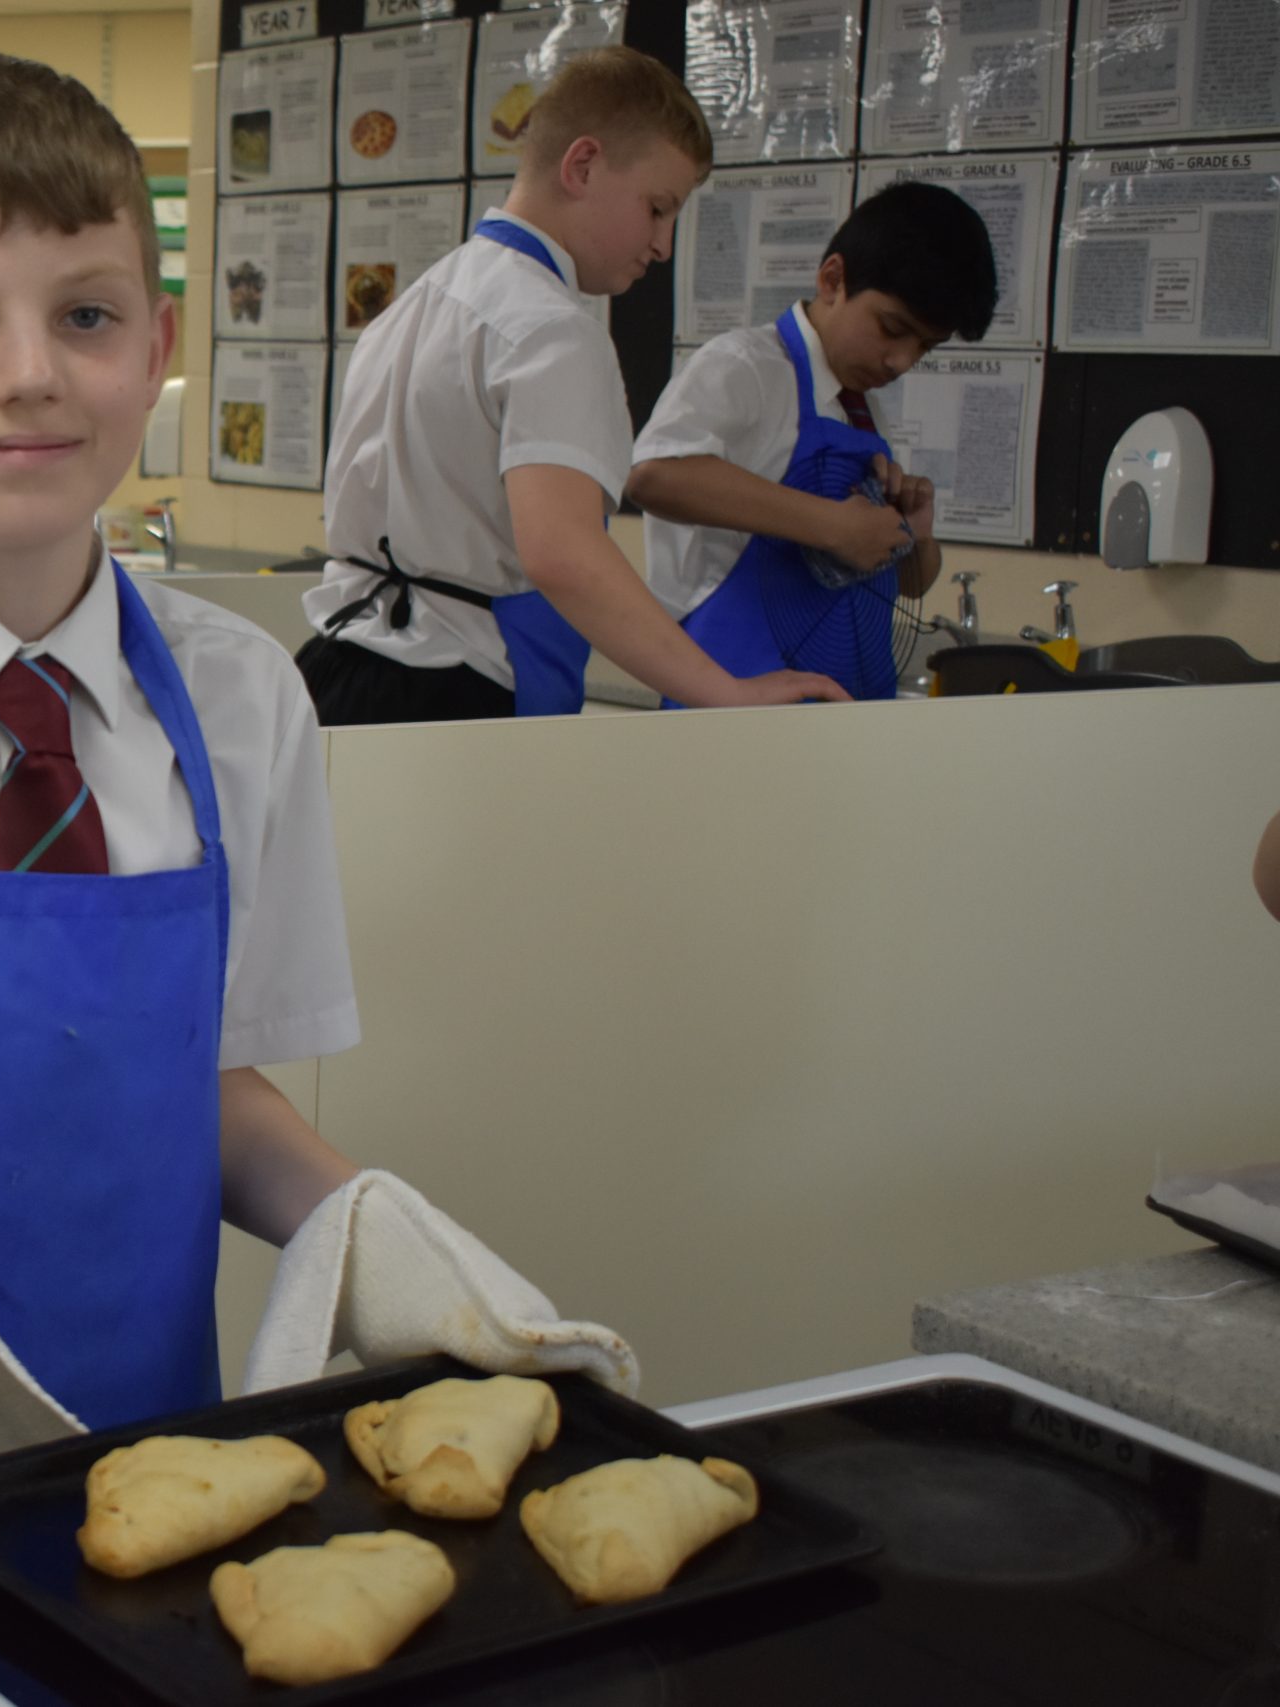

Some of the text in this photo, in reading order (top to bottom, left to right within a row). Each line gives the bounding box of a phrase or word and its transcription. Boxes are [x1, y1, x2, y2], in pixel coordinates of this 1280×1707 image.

[249, 6, 306, 36] YEAR 7
[1187, 155, 1228, 169] GRADE
[1232, 154, 1251, 168] 6.5
[963, 164, 998, 177] GRADE
[1000, 163, 1017, 176] 4.5
[772, 174, 801, 188] GRADE
[949, 359, 982, 374] GRADE
[985, 360, 1001, 375] 5.5
